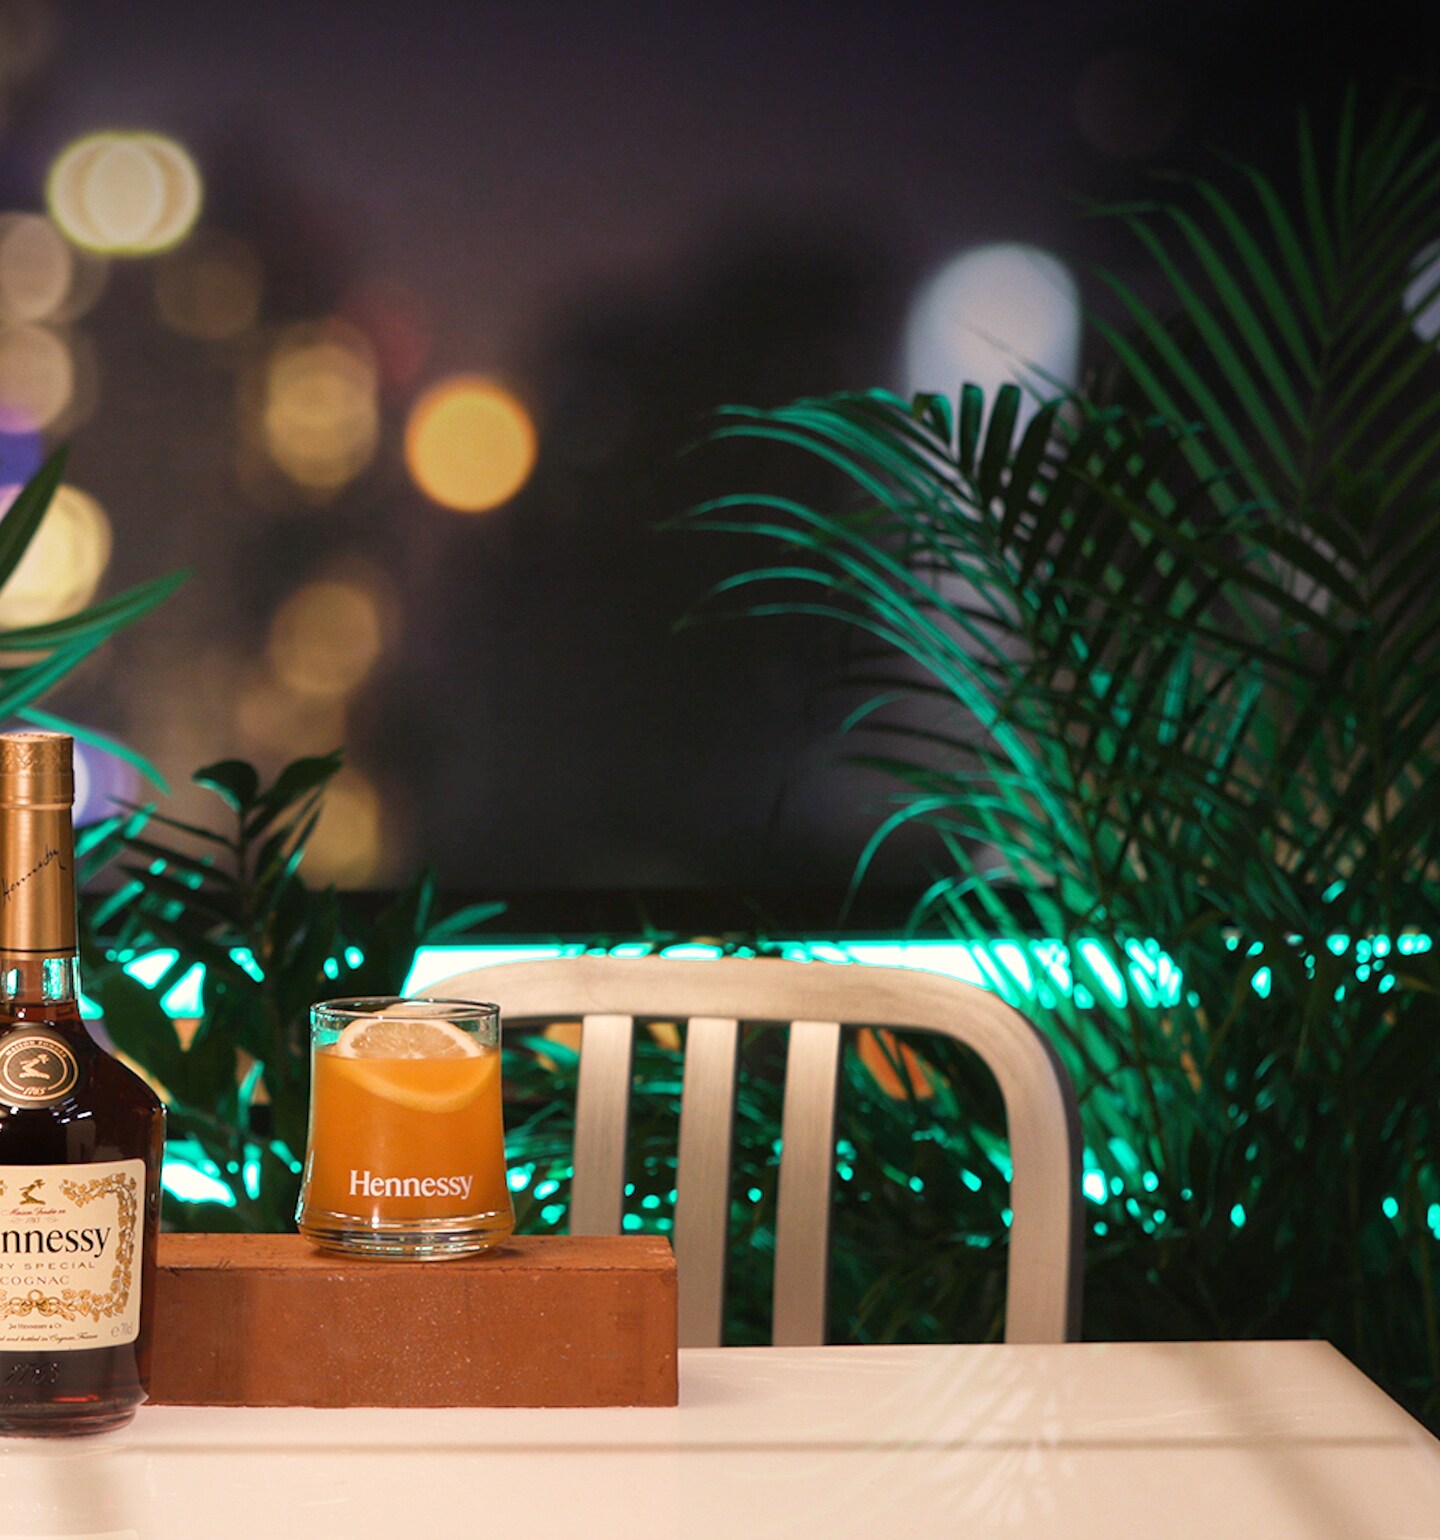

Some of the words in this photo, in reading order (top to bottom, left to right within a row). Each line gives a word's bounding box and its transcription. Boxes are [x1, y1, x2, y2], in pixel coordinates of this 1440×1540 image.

[5, 1040, 36, 1056] MAISON
[22, 1085, 47, 1096] 1765
[349, 1169, 473, 1200] Hennessy
[24, 1261, 96, 1271] SPECIAL
[0, 1275, 70, 1286] COGNAC
